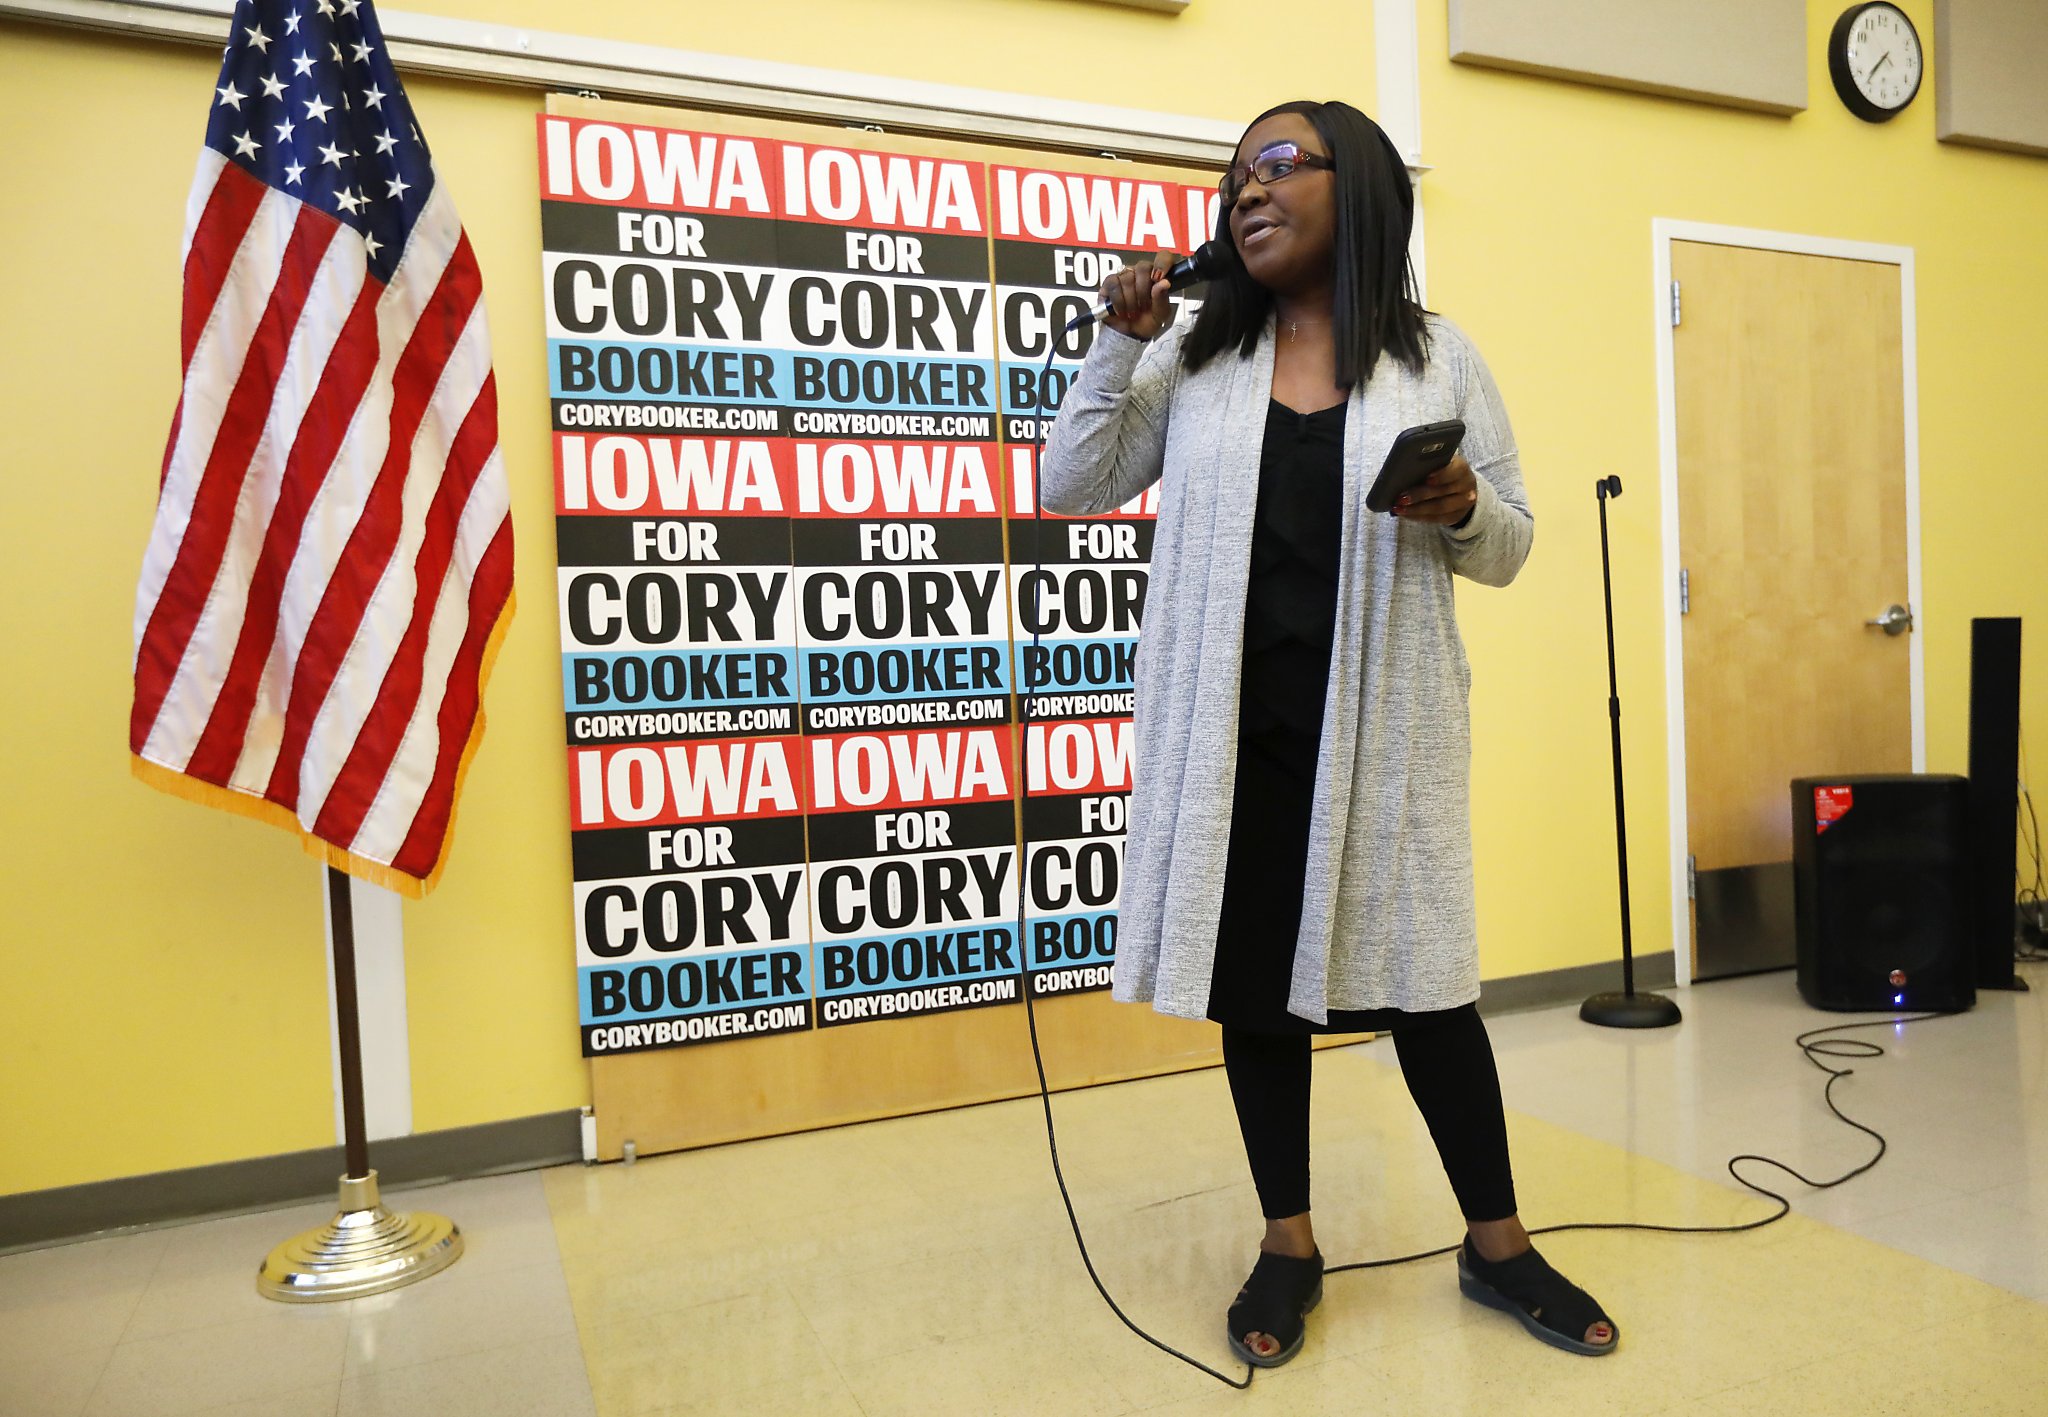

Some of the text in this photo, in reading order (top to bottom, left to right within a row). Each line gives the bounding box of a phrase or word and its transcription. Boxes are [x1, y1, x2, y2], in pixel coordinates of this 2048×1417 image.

[1857, 32, 1867, 42] 10
[1865, 18, 1874, 30] 11
[546, 120, 770, 213] IOWA
[782, 145, 982, 231] IOWA
[998, 170, 1176, 248] IOWA
[618, 212, 707, 257] FOR
[846, 232, 924, 274] FOR
[553, 259, 774, 342] CORY
[788, 276, 986, 352] CORY
[558, 345, 778, 399] BOOKER
[793, 356, 989, 406] BOOKER
[560, 403, 778, 430] CORYBOOKER.COM
[794, 412, 990, 436] CORYBOOKER.COM
[562, 435, 784, 511] IOWA
[796, 444, 996, 514] IOWA
[632, 521, 720, 561] FOR
[860, 523, 939, 561] FOR
[1068, 524, 1138, 560] FOR
[568, 572, 788, 645] CORY
[803, 570, 1000, 641] CORY
[1018, 569, 1149, 634] COR
[574, 653, 790, 704] BOOKER
[808, 647, 1003, 697] BOOKER
[1023, 642, 1138, 687] BOOK
[575, 708, 790, 738] CORYBOOKER.COM
[810, 700, 1004, 729] CORYBOOKER.COM
[1025, 694, 1134, 717] CORYBOOKE
[812, 730, 1008, 808] IOWA
[1027, 722, 1135, 791] IOW
[578, 742, 798, 824] IOWA
[875, 810, 952, 852] FOR
[1081, 796, 1132, 833] FO
[648, 826, 735, 871] FOR
[818, 852, 1012, 934] CORY
[1030, 842, 1126, 910] CO
[584, 870, 802, 958] CORY
[1034, 914, 1118, 963] BOO
[590, 951, 804, 1017] BOOKER
[822, 928, 1014, 990] BOOKER
[824, 979, 1015, 1022] CORYBOOKER.COM
[591, 1006, 806, 1050] CORYBOOKER.COM
